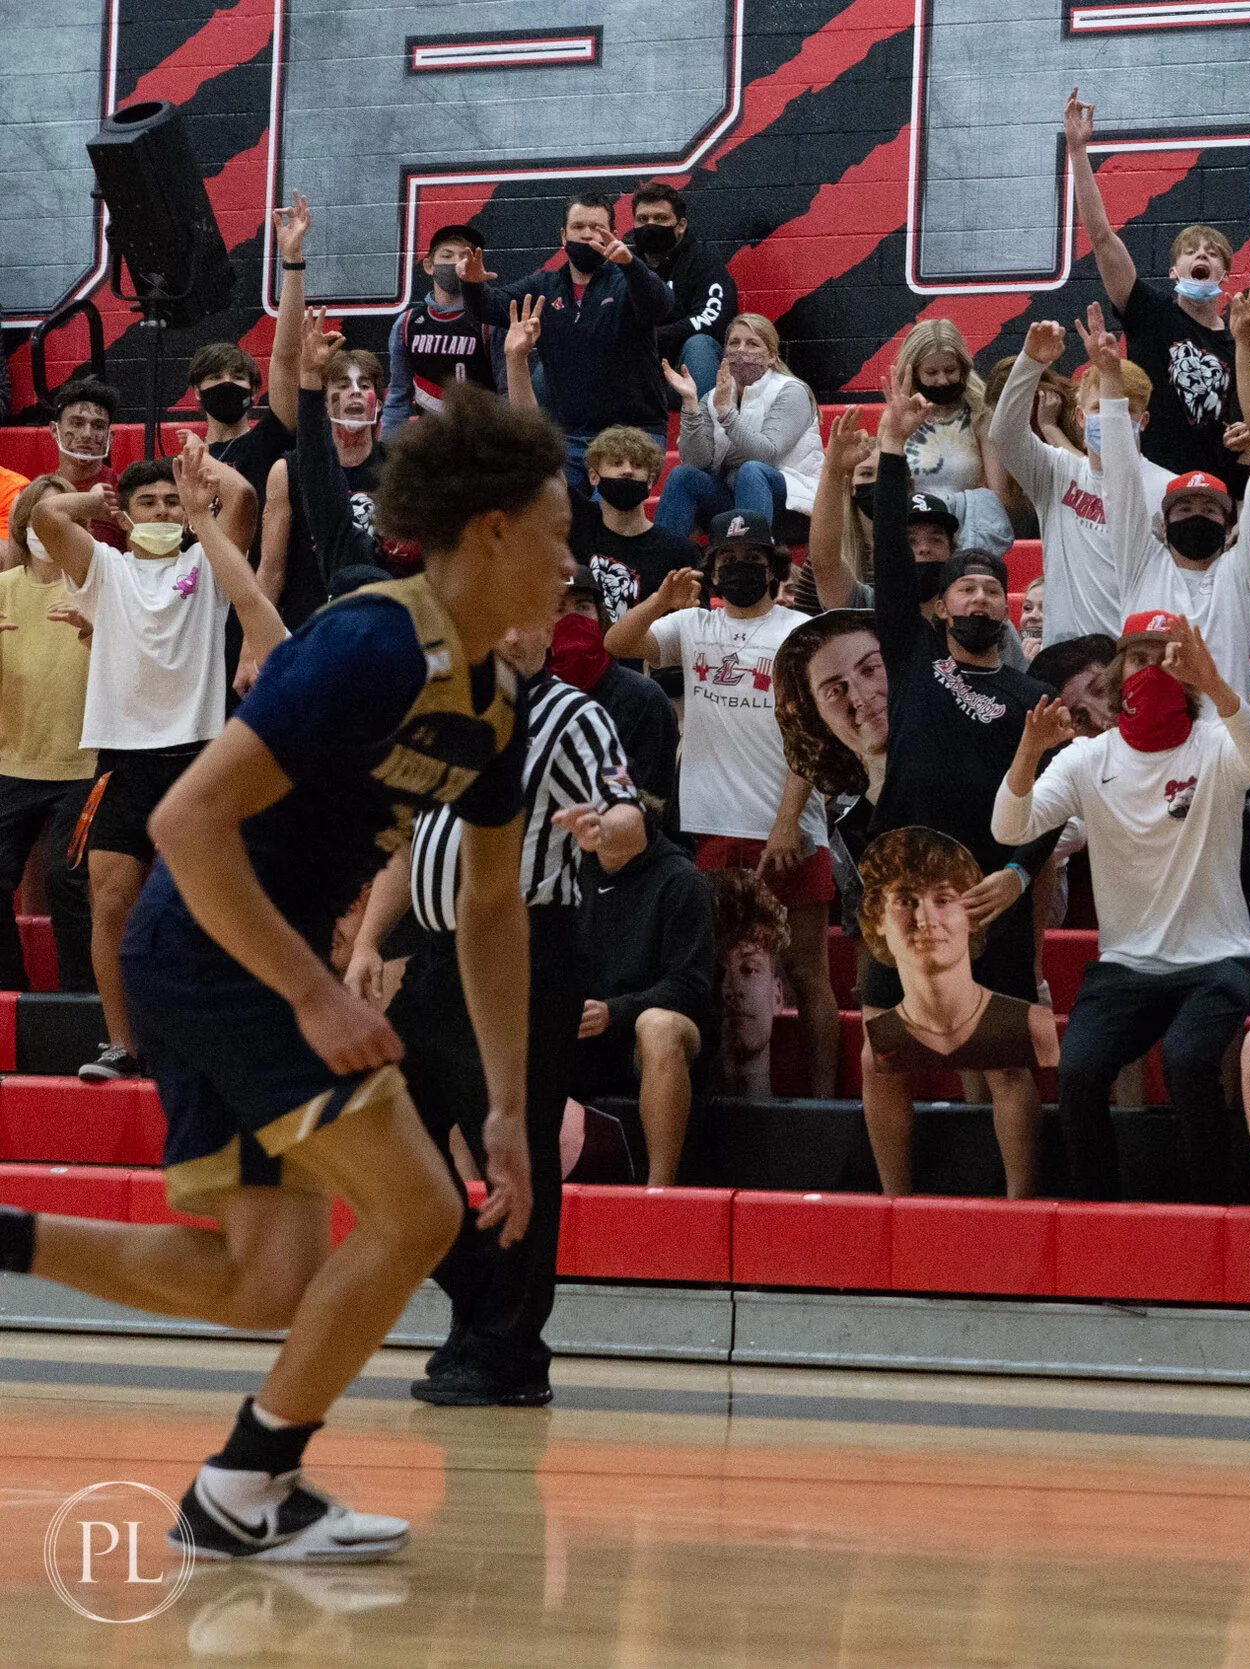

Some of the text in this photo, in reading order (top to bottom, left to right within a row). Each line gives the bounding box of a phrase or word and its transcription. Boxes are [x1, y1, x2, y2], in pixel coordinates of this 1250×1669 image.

[689, 282, 724, 331] CCDM
[411, 334, 477, 355] PORTLAND
[934, 671, 978, 721] BASBALL
